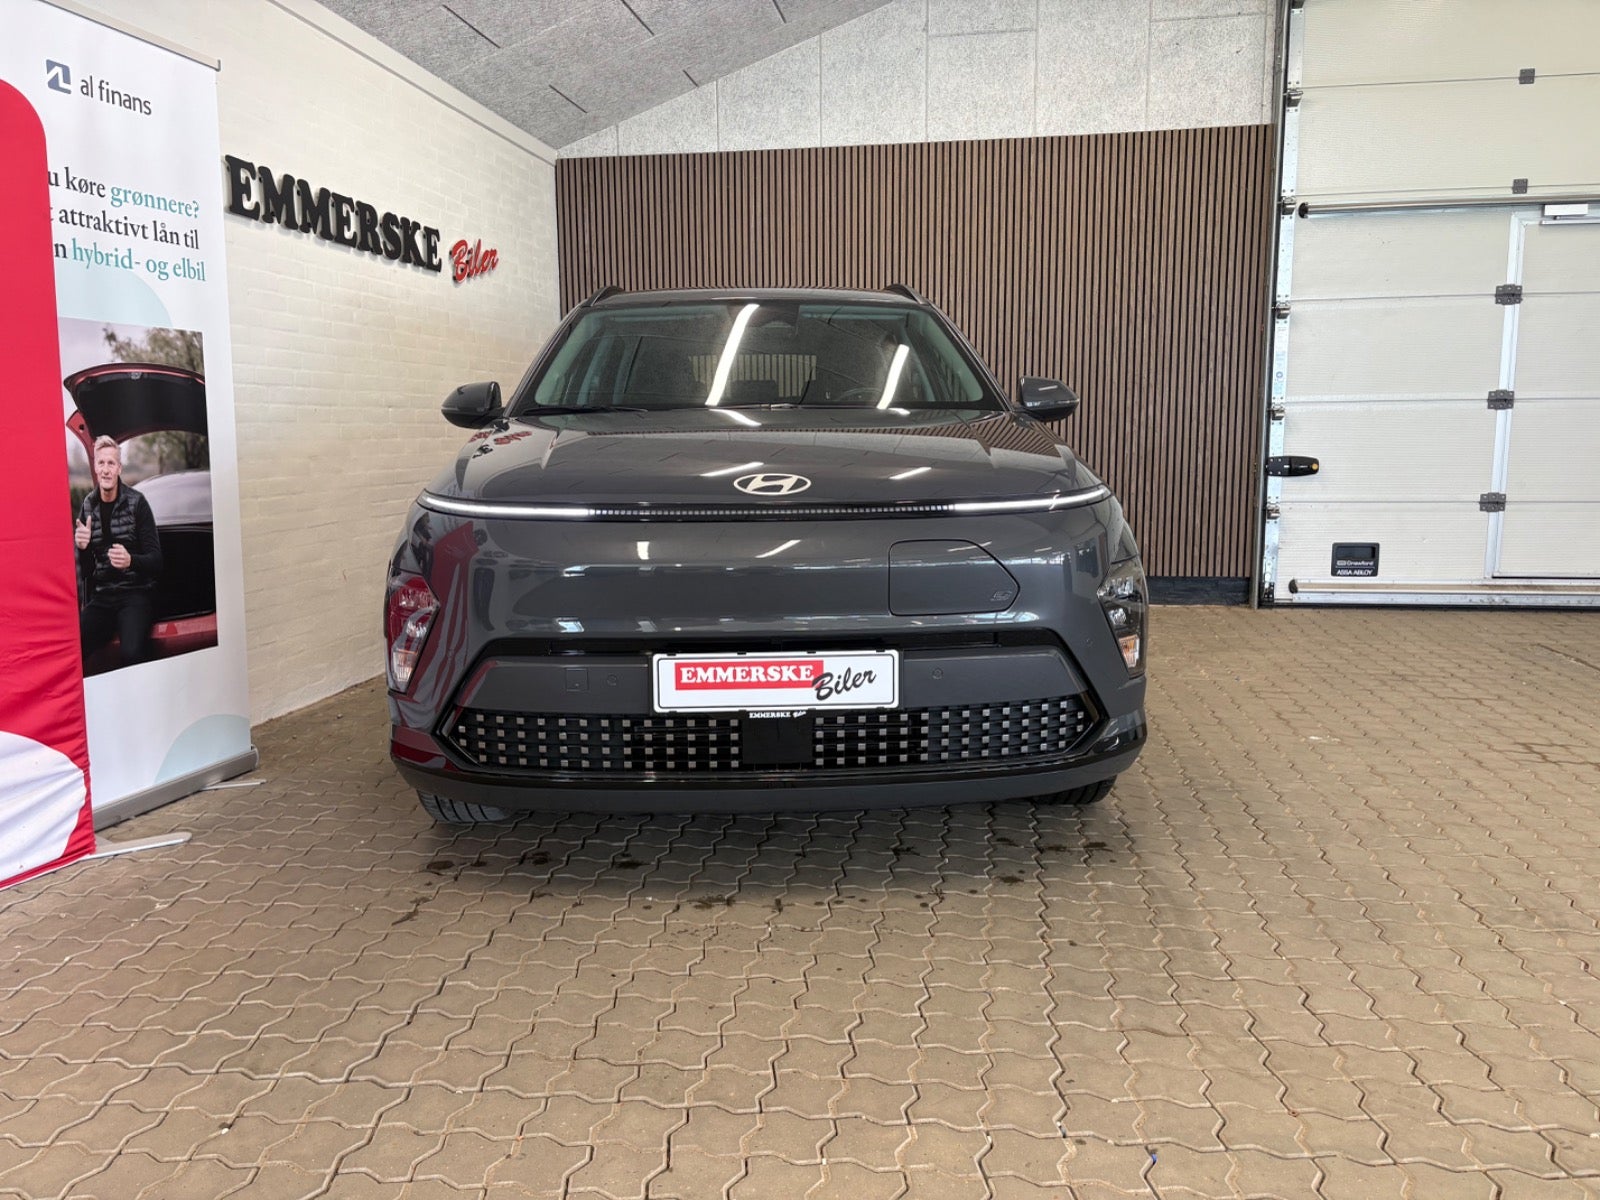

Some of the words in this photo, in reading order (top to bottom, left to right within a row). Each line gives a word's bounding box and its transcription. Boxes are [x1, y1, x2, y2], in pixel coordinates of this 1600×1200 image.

[80, 75, 94, 98] al
[98, 79, 152, 115] finans
[48, 171, 60, 187] u
[64, 166, 106, 198] køre
[110, 186, 200, 218] grønnere?
[58, 208, 149, 240] attraktivt
[153, 220, 180, 246] lån
[183, 229, 200, 250] til
[225, 154, 442, 272] EMMERSKE
[450, 239, 499, 284] Biler
[54, 242, 68, 259] n
[72, 237, 141, 270] hybrid-
[146, 257, 169, 281] og
[173, 257, 206, 282] elbil
[680, 665, 814, 683] EMMERSKE
[812, 667, 877, 701] Biler
